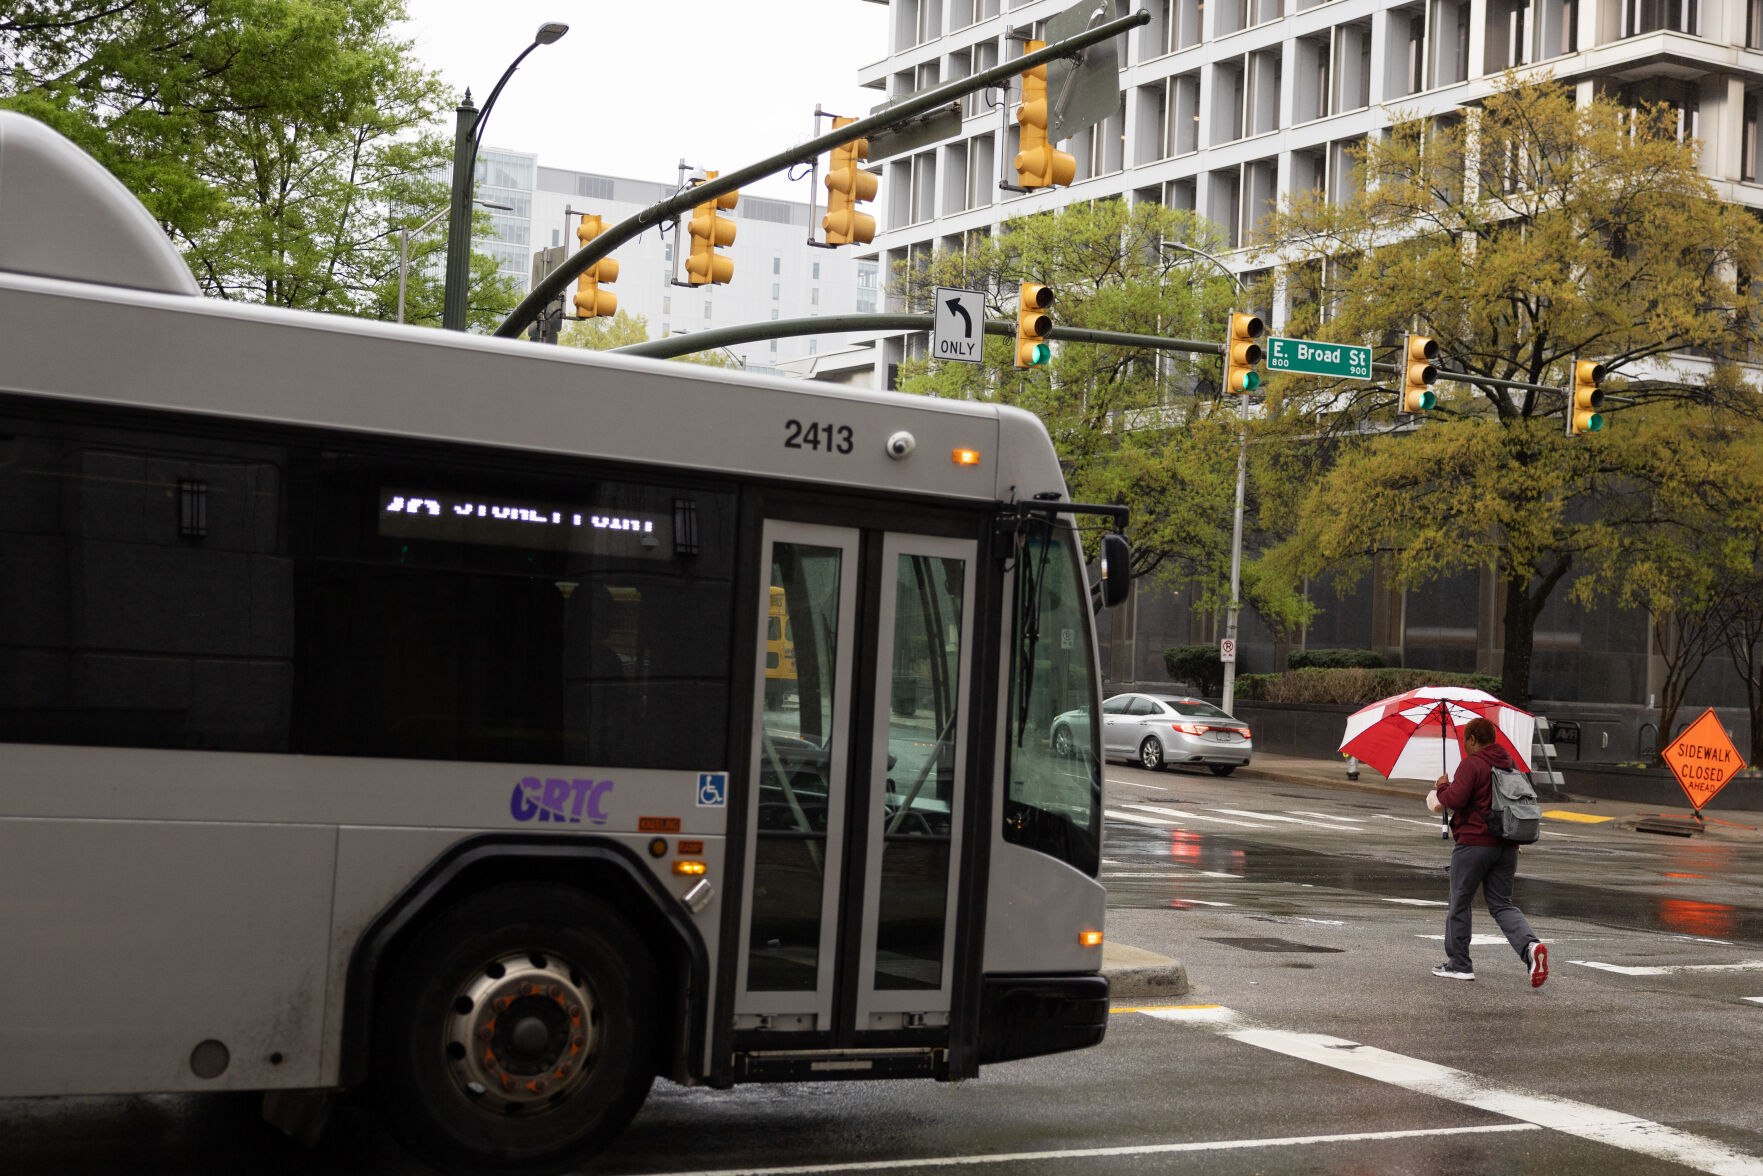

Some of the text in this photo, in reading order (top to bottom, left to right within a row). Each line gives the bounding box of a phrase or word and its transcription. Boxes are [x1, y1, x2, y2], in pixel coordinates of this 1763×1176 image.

[941, 340, 975, 356] ONLY
[1273, 342, 1366, 366] E. Broad St
[1272, 358, 1289, 367] 800
[1350, 366, 1367, 375] 900
[784, 419, 854, 455] 2413
[1678, 744, 1731, 762] SIDEWALK
[1682, 764, 1723, 782] CLOSED
[1688, 781, 1715, 793] AHEAD
[510, 776, 614, 825] GRTC
